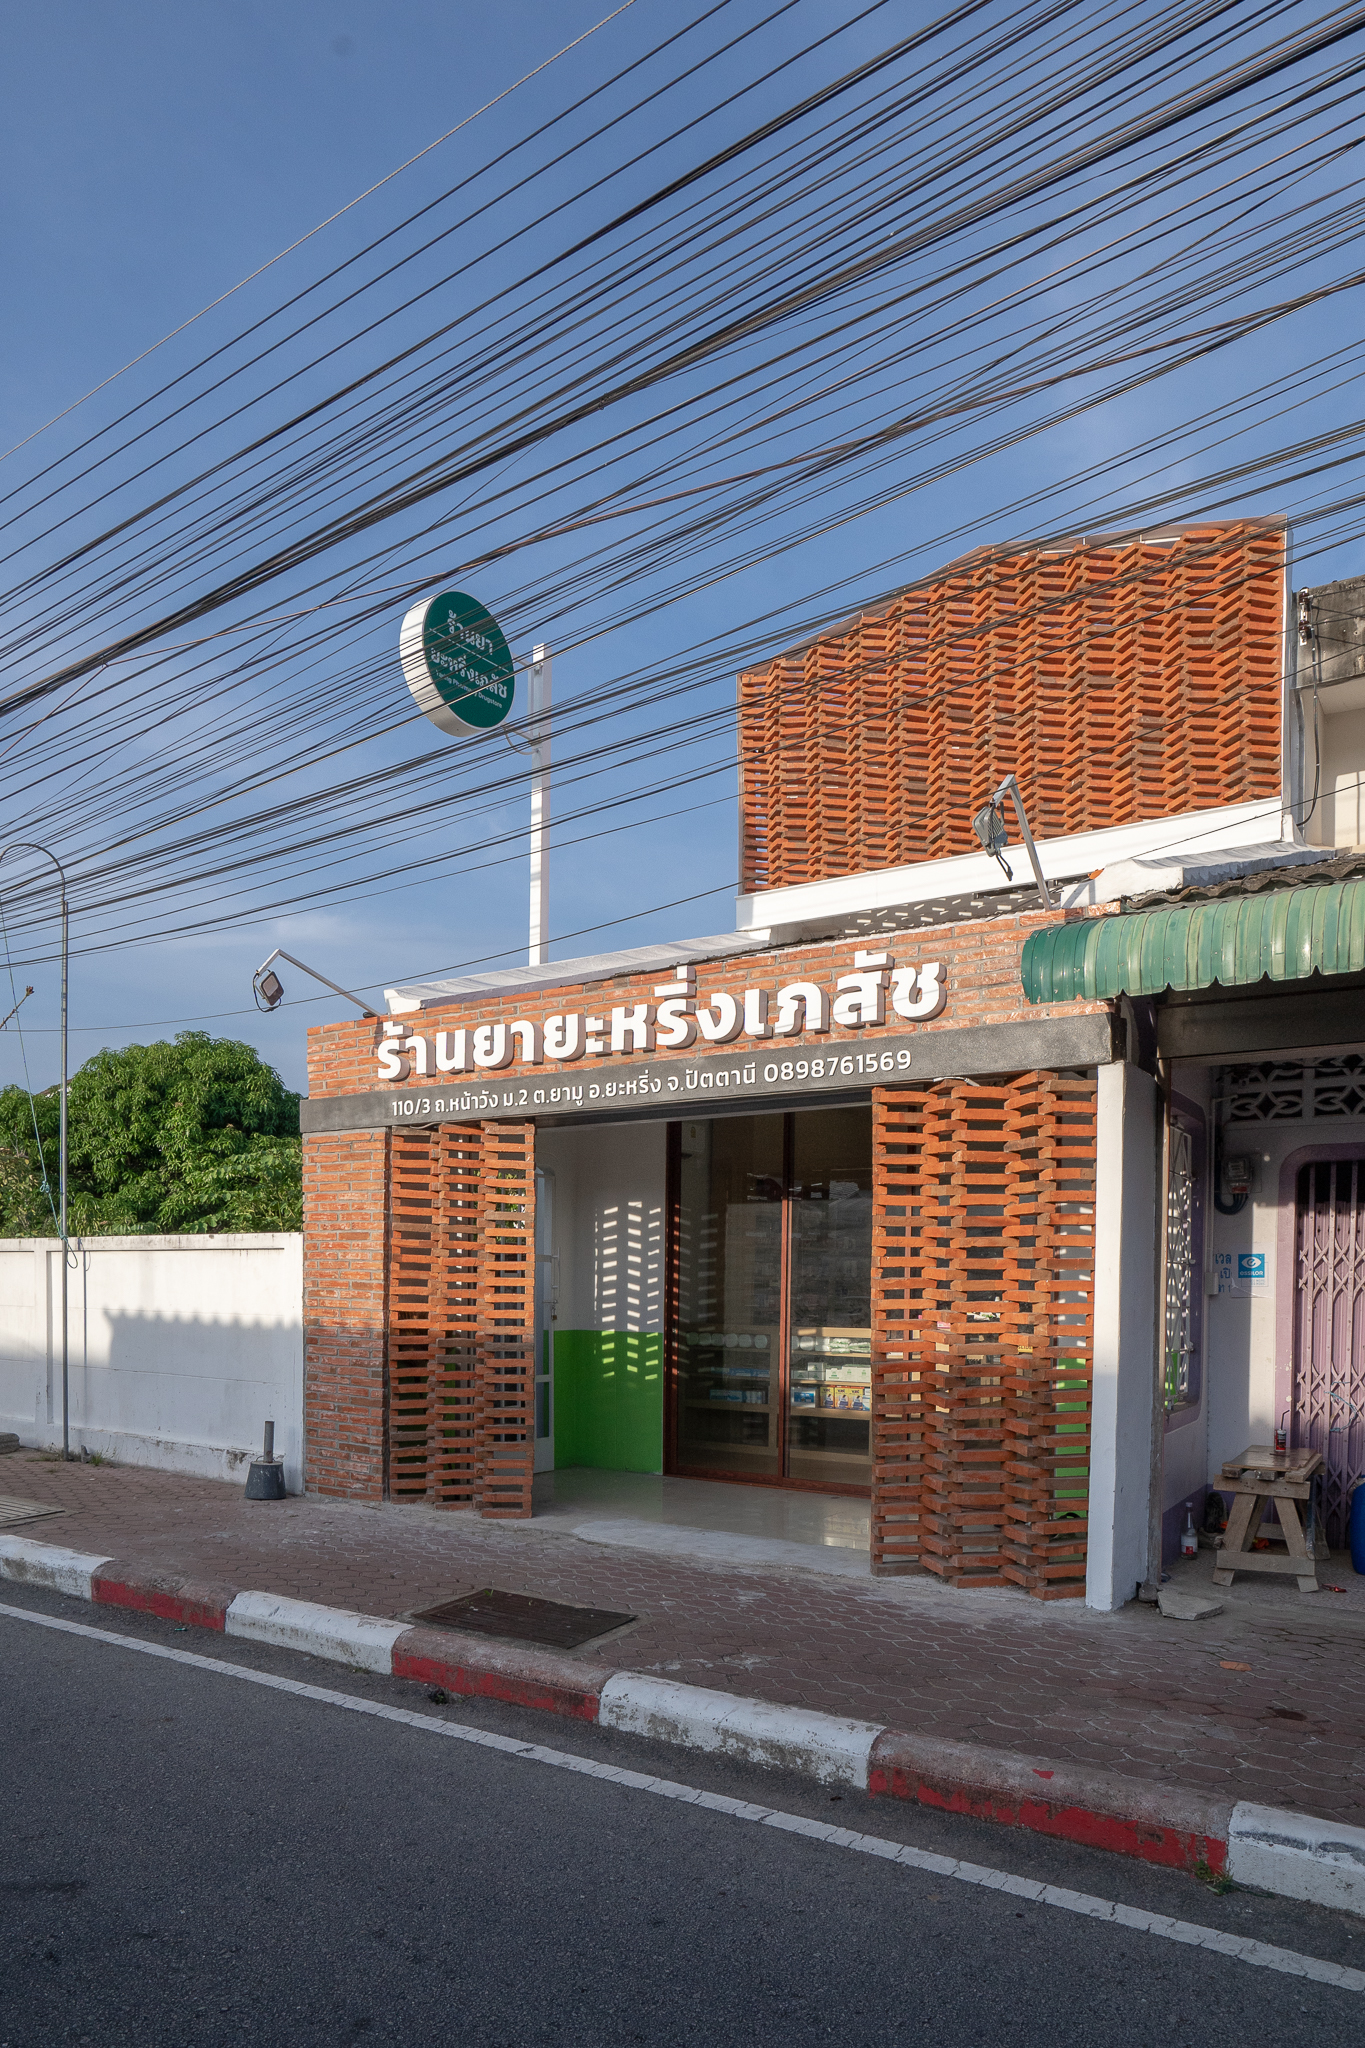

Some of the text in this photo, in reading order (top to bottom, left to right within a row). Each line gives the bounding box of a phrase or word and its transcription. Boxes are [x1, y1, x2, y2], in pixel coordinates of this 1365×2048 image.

[377, 950, 945, 1082] ร้านยายะหริ่งเภสัช
[391, 1049, 912, 1116] 110/3 ถ.หน้าวัง ม.2 ต.ยามู อ.ยะหริ่ง จ.ปัตตานี 0898761569
